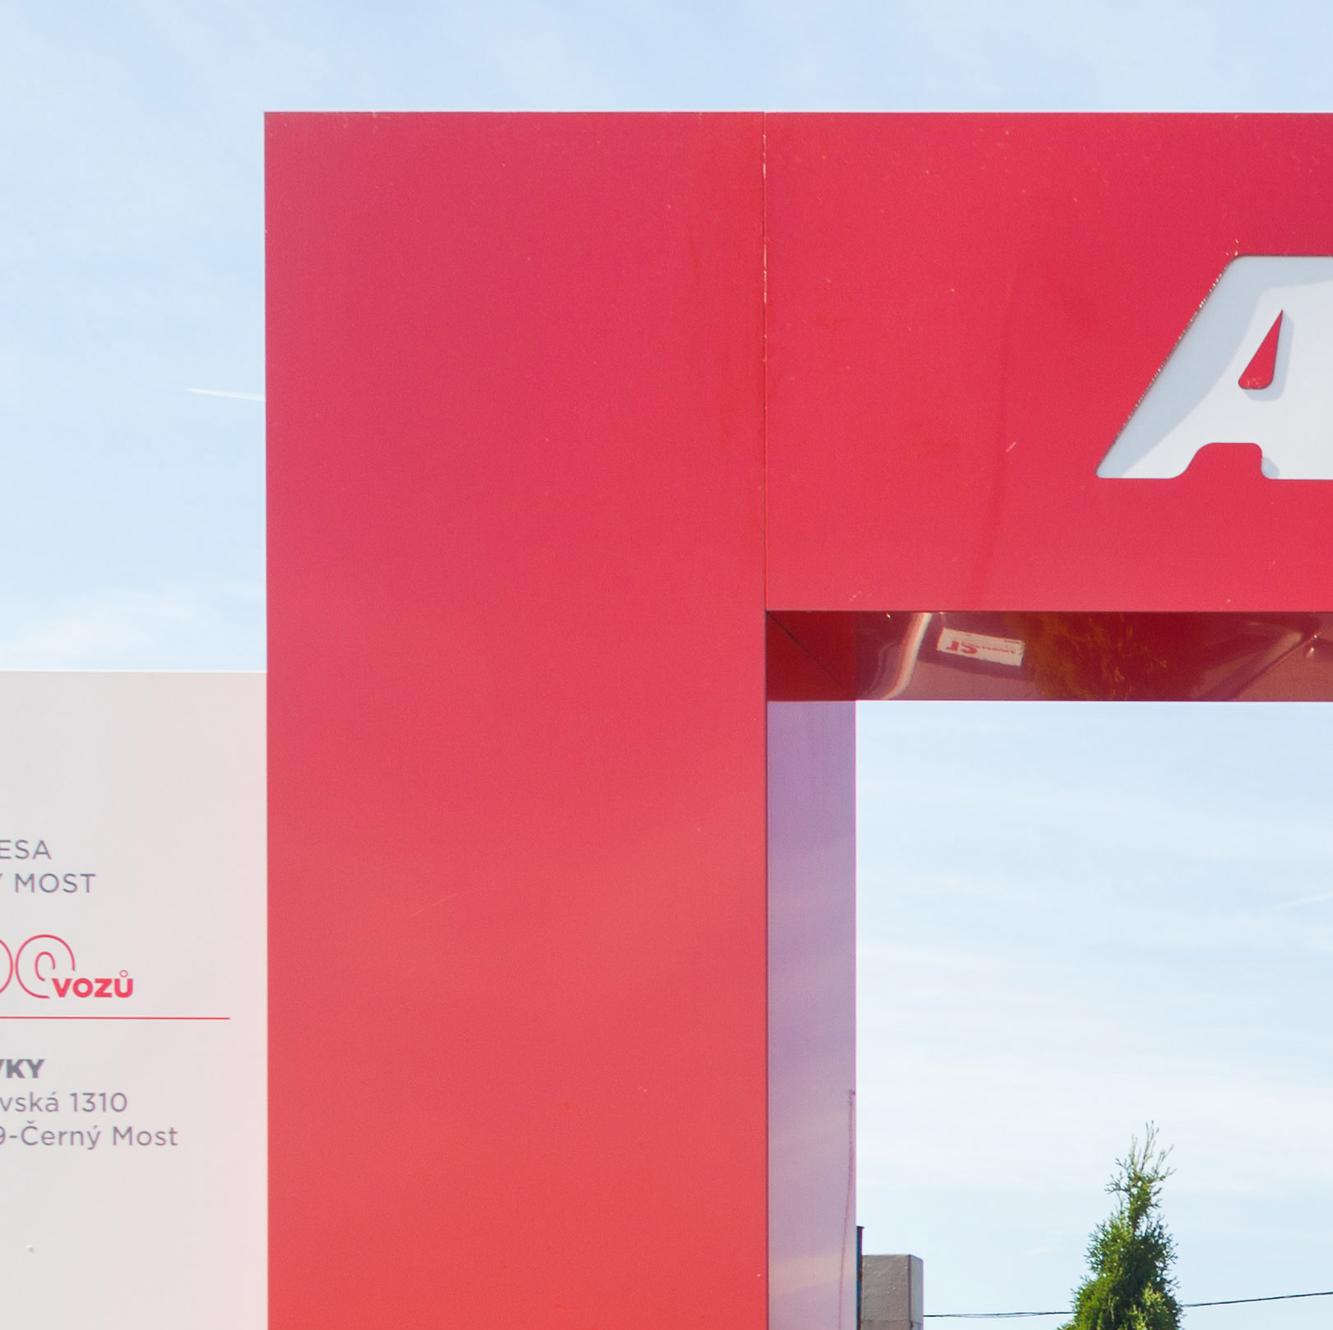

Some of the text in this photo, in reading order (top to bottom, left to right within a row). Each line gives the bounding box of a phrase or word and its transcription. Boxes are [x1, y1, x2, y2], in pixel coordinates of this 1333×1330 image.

[15, 873, 96, 894] MOST
[51, 969, 134, 999] VOZŮ
[70, 1092, 128, 1113] 1310
[113, 1126, 179, 1146] Most
